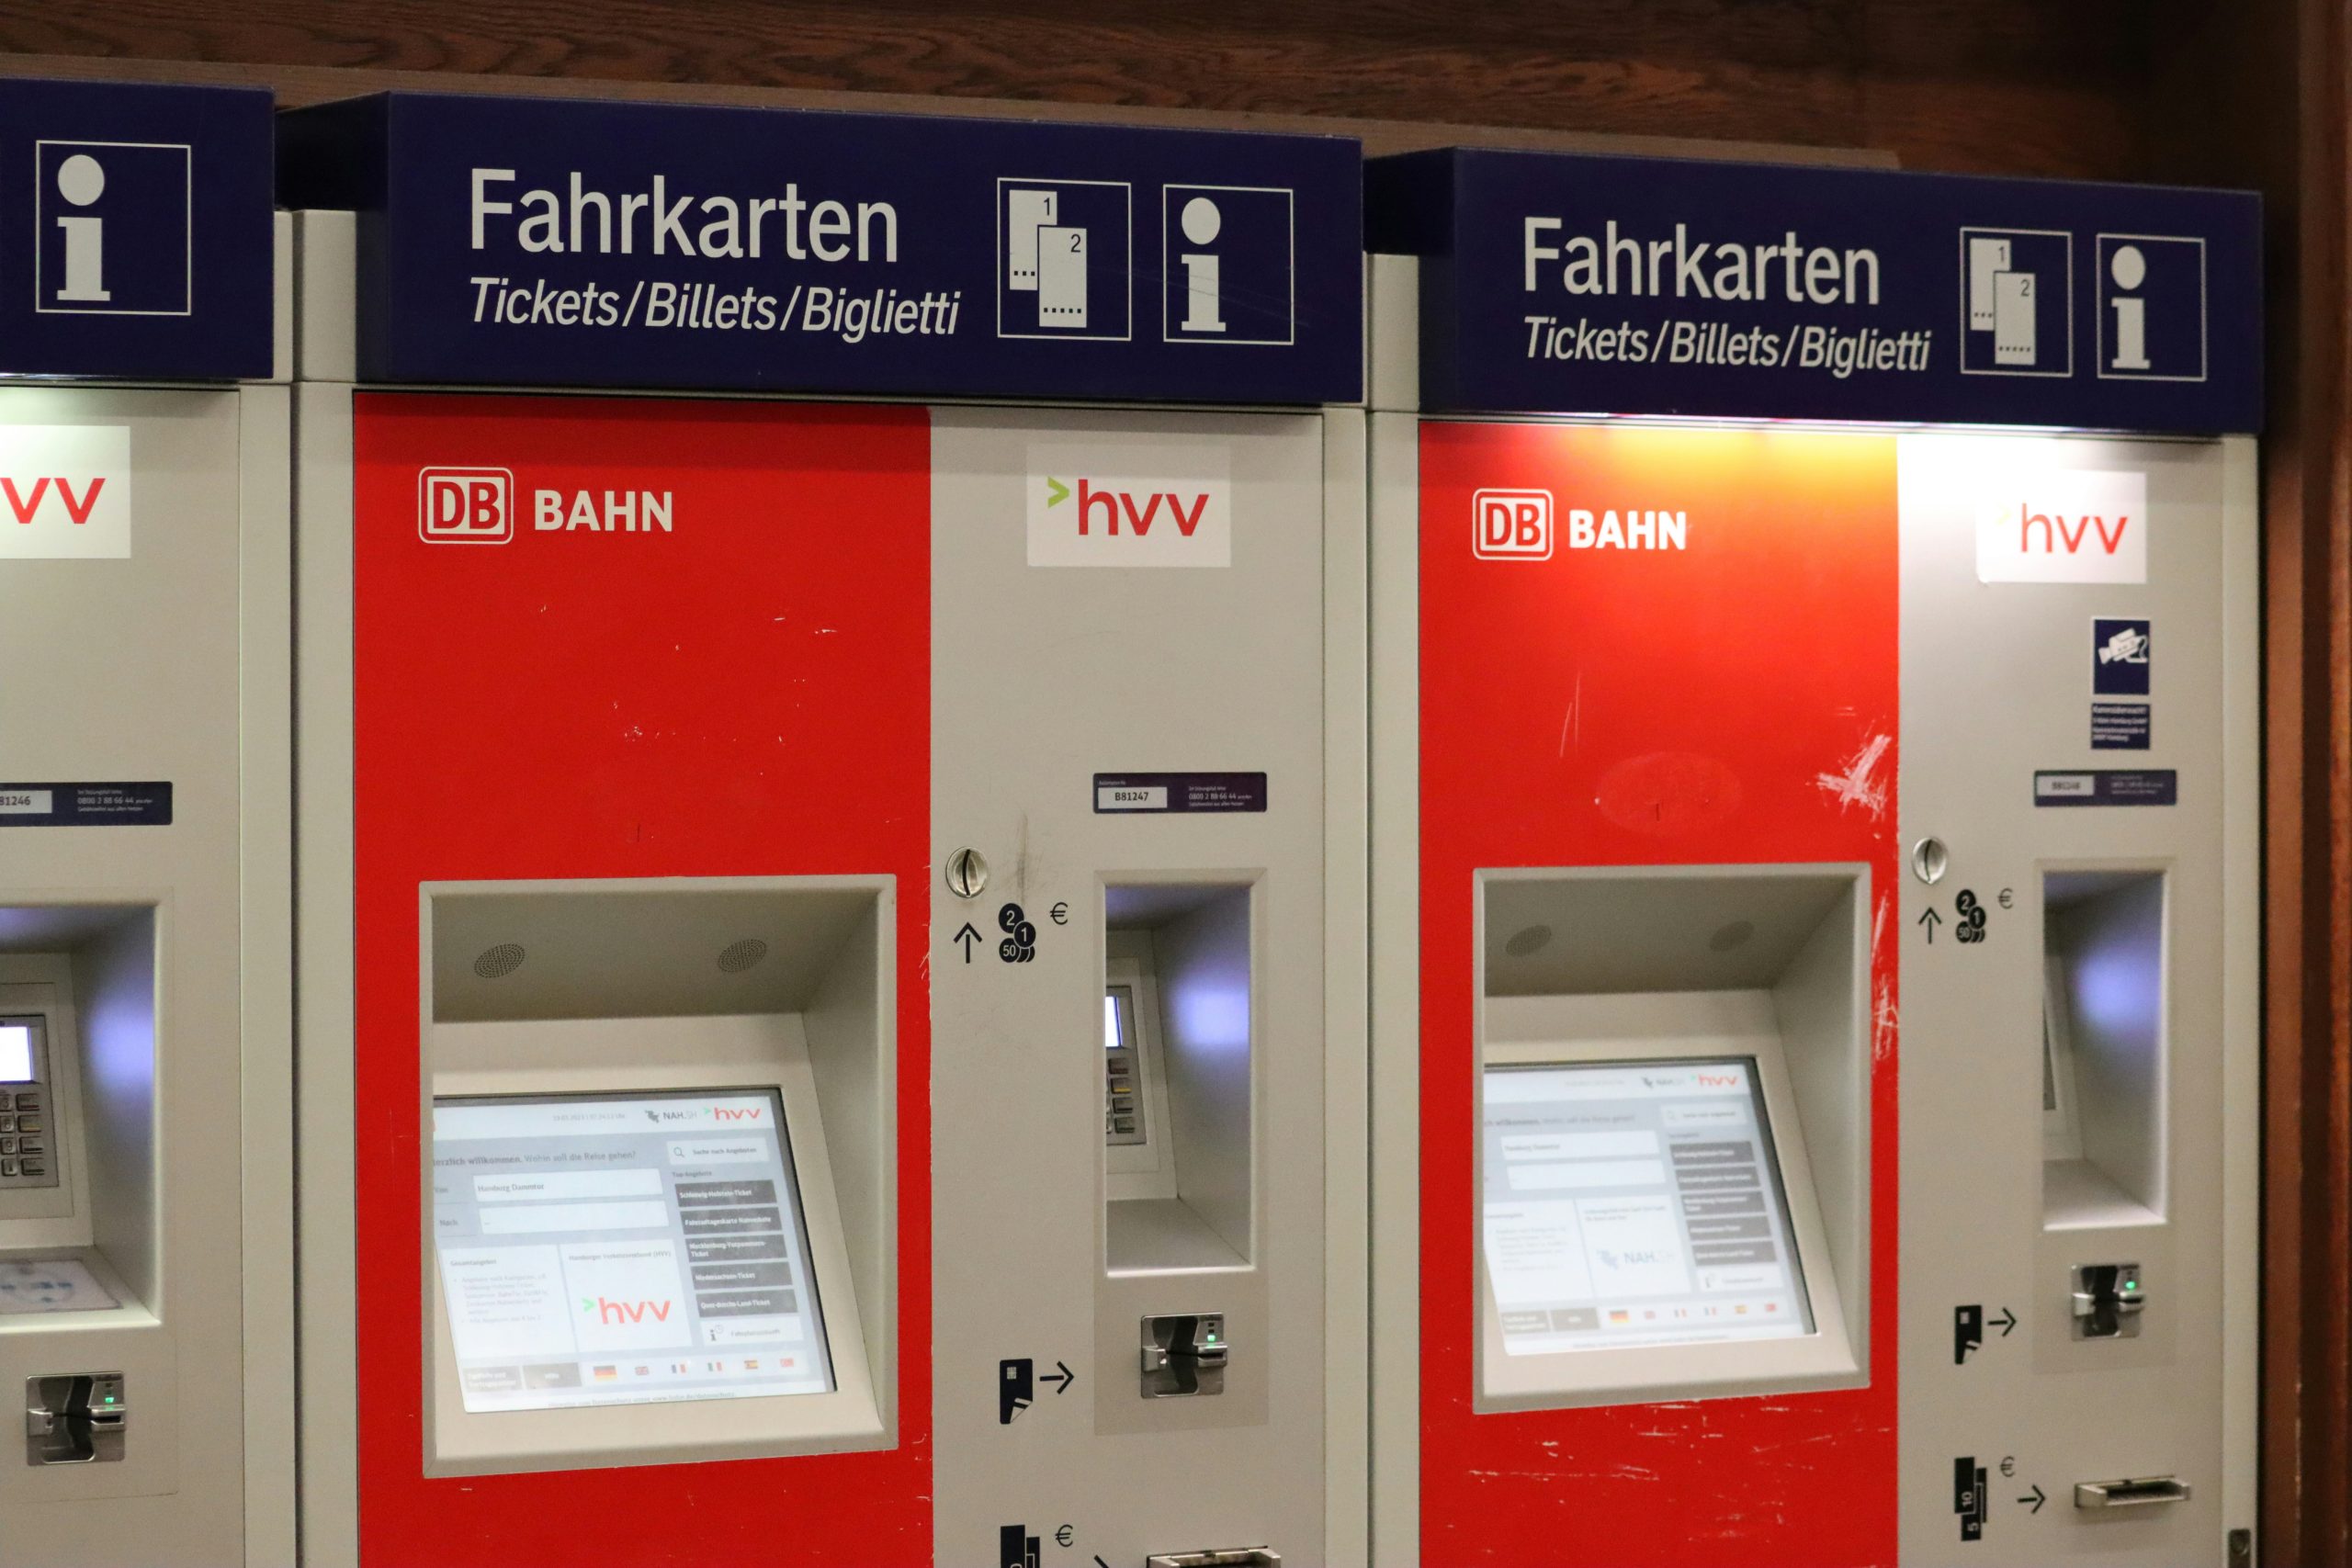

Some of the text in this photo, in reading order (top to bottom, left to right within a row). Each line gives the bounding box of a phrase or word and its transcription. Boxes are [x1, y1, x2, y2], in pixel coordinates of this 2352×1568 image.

[470, 167, 898, 263] Fahrkarten
[1043, 197, 1051, 216] 1
[1070, 234, 1081, 253] 2
[1523, 217, 1881, 306] Fahrkarten
[1997, 246, 2006, 263] 1
[2020, 278, 2031, 297] 2
[433, 480, 673, 533] DB BAHN
[1484, 502, 1688, 551] DB BAHN
[1114, 791, 1149, 802] B81247
[1961, 895, 1970, 909] 2
[1006, 909, 1015, 927] 2
[1021, 928, 1028, 942] 1
[1002, 944, 1016, 957] 50
[598, 1296, 671, 1325] hvv
